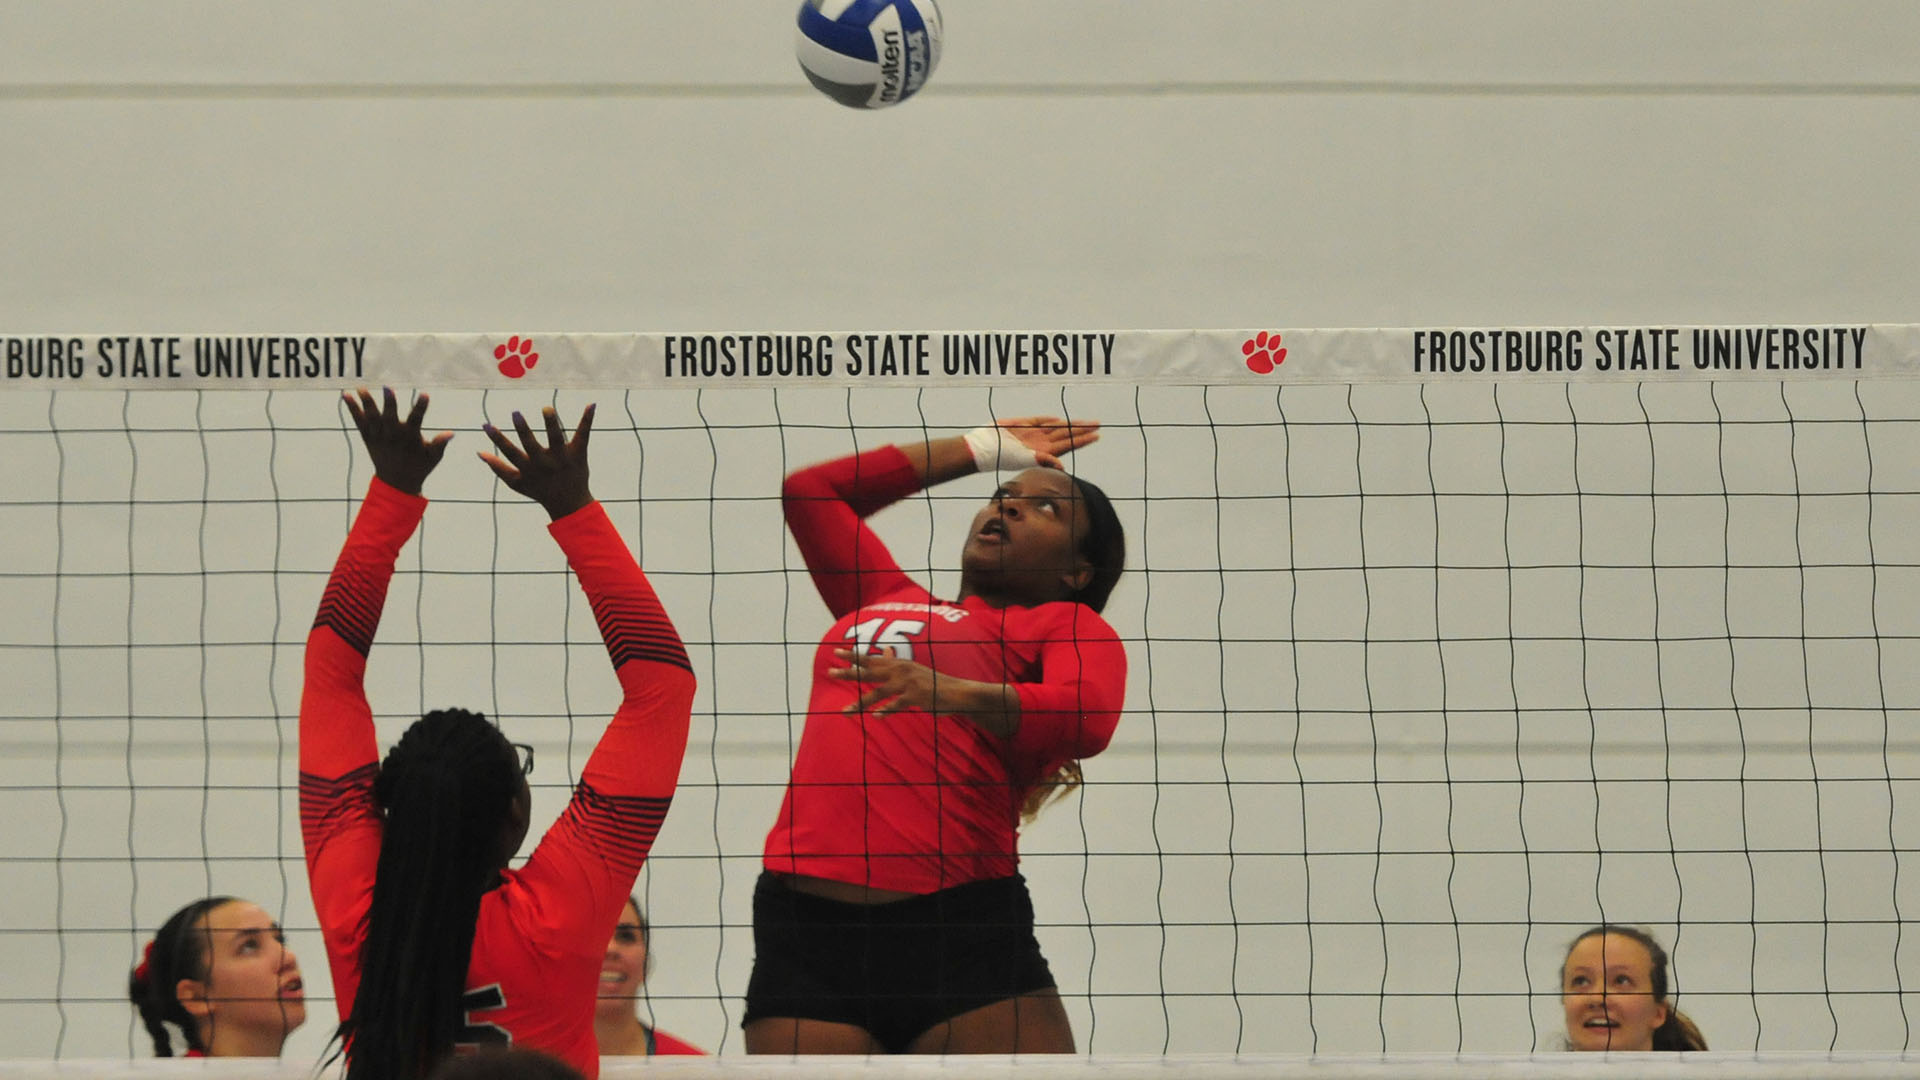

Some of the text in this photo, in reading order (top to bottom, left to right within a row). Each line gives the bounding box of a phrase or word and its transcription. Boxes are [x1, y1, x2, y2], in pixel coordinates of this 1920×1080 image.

[880, 30, 900, 102] molten
[0, 337, 366, 379] BURG STATE UNIVERSITY
[665, 333, 1115, 378] FROSTBURG STATE UNIVERSITY
[1414, 327, 1867, 373] FROSTBURG STATE UNIVERSITY
[844, 617, 926, 664] 15
